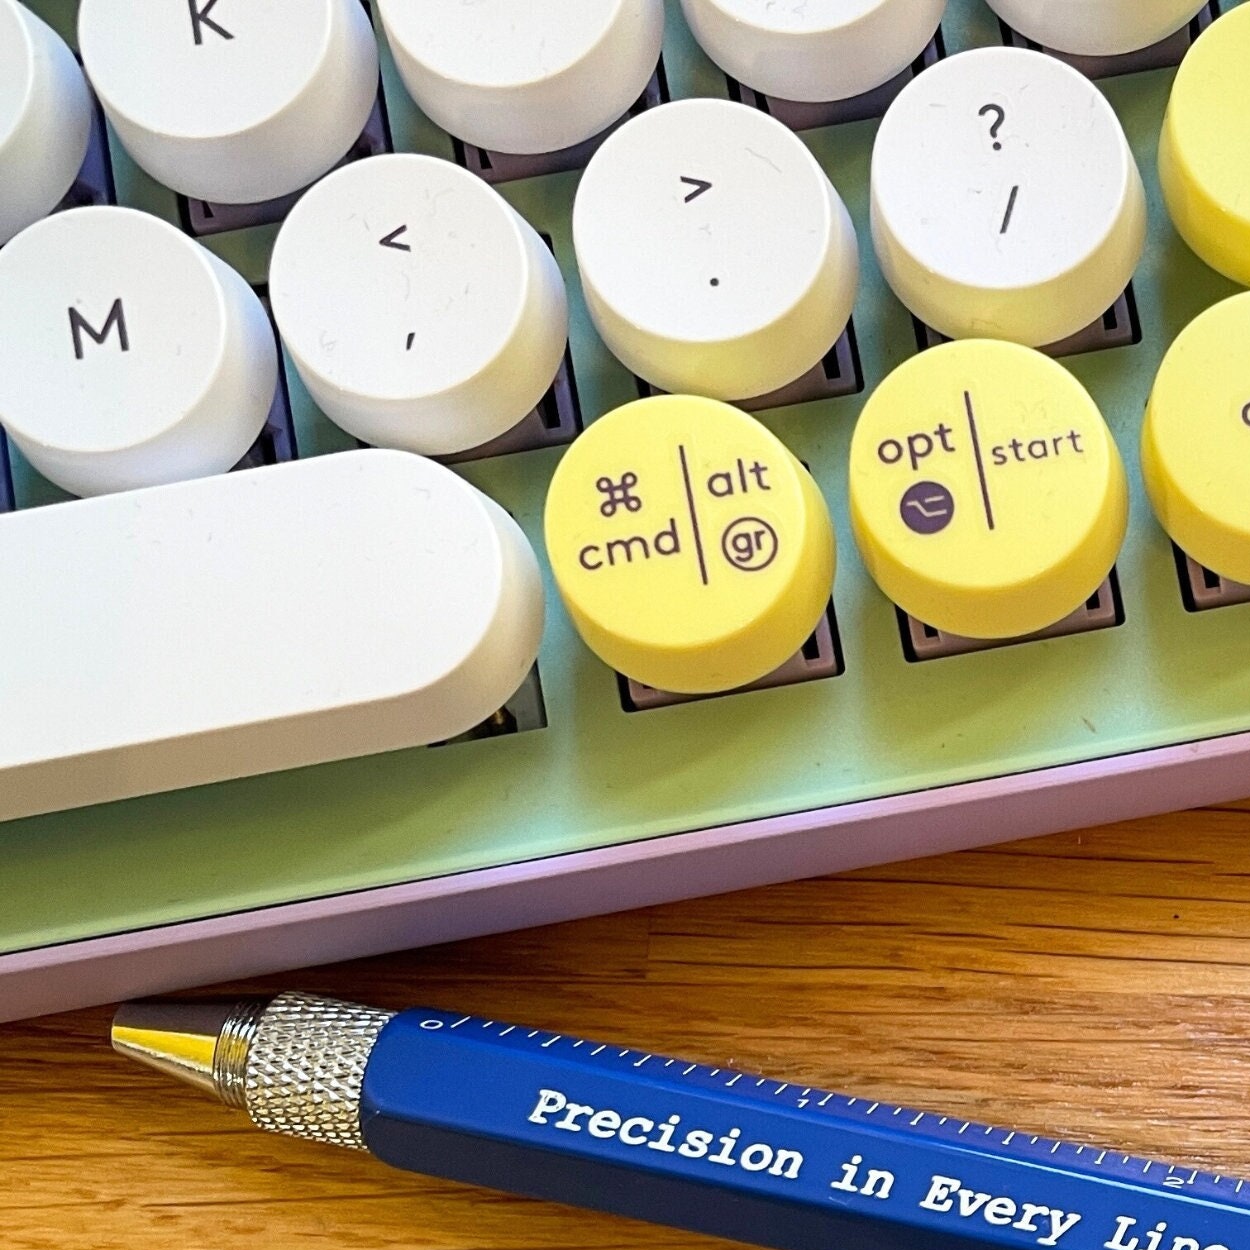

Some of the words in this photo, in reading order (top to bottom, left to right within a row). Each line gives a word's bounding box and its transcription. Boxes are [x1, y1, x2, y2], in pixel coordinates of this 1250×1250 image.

[187, 0, 235, 46] K
[978, 103, 1006, 151] ?
[68, 297, 130, 360] M
[876, 423, 956, 472] opt
[991, 430, 1085, 466] start
[706, 457, 772, 498] alt
[579, 517, 681, 570] cmd
[731, 530, 766, 562] gr
[419, 1019, 444, 1030] 0
[1162, 1176, 1185, 1189] 2
[527, 1088, 805, 1180] Precision
[830, 1154, 896, 1199] in
[918, 1173, 1083, 1247] Every
